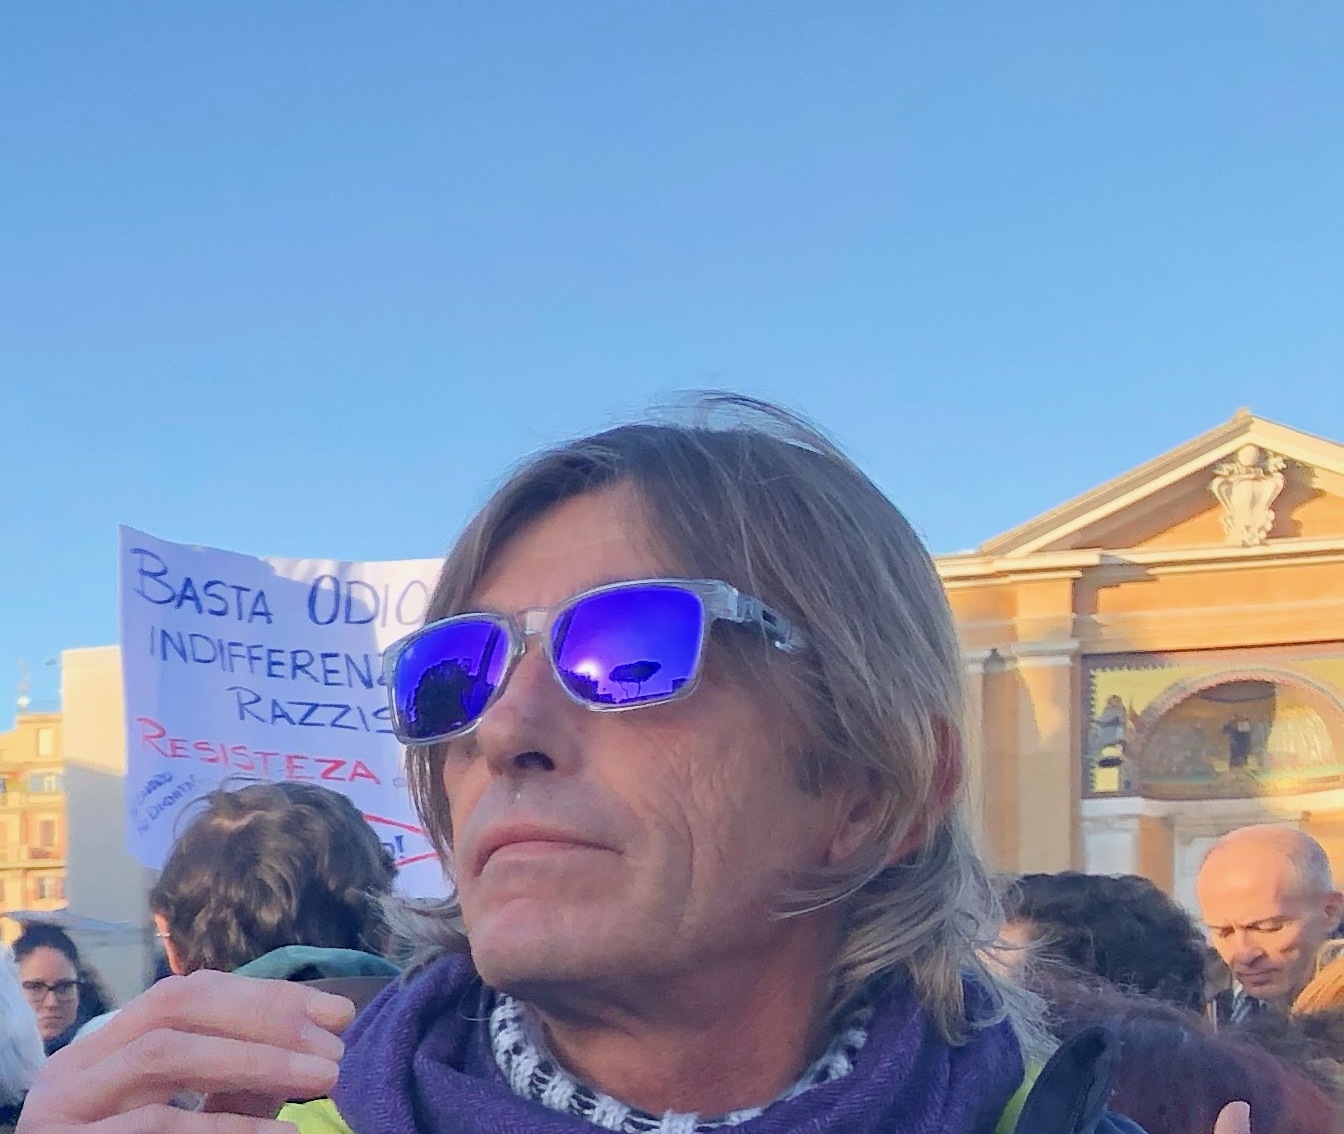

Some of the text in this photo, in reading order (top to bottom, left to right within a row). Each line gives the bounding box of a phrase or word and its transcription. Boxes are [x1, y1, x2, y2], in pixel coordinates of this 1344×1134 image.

[130, 548, 429, 627] BASTA ODIO
[149, 626, 390, 690] INDIFFEREN
[136, 717, 381, 786] RESISTEZA
